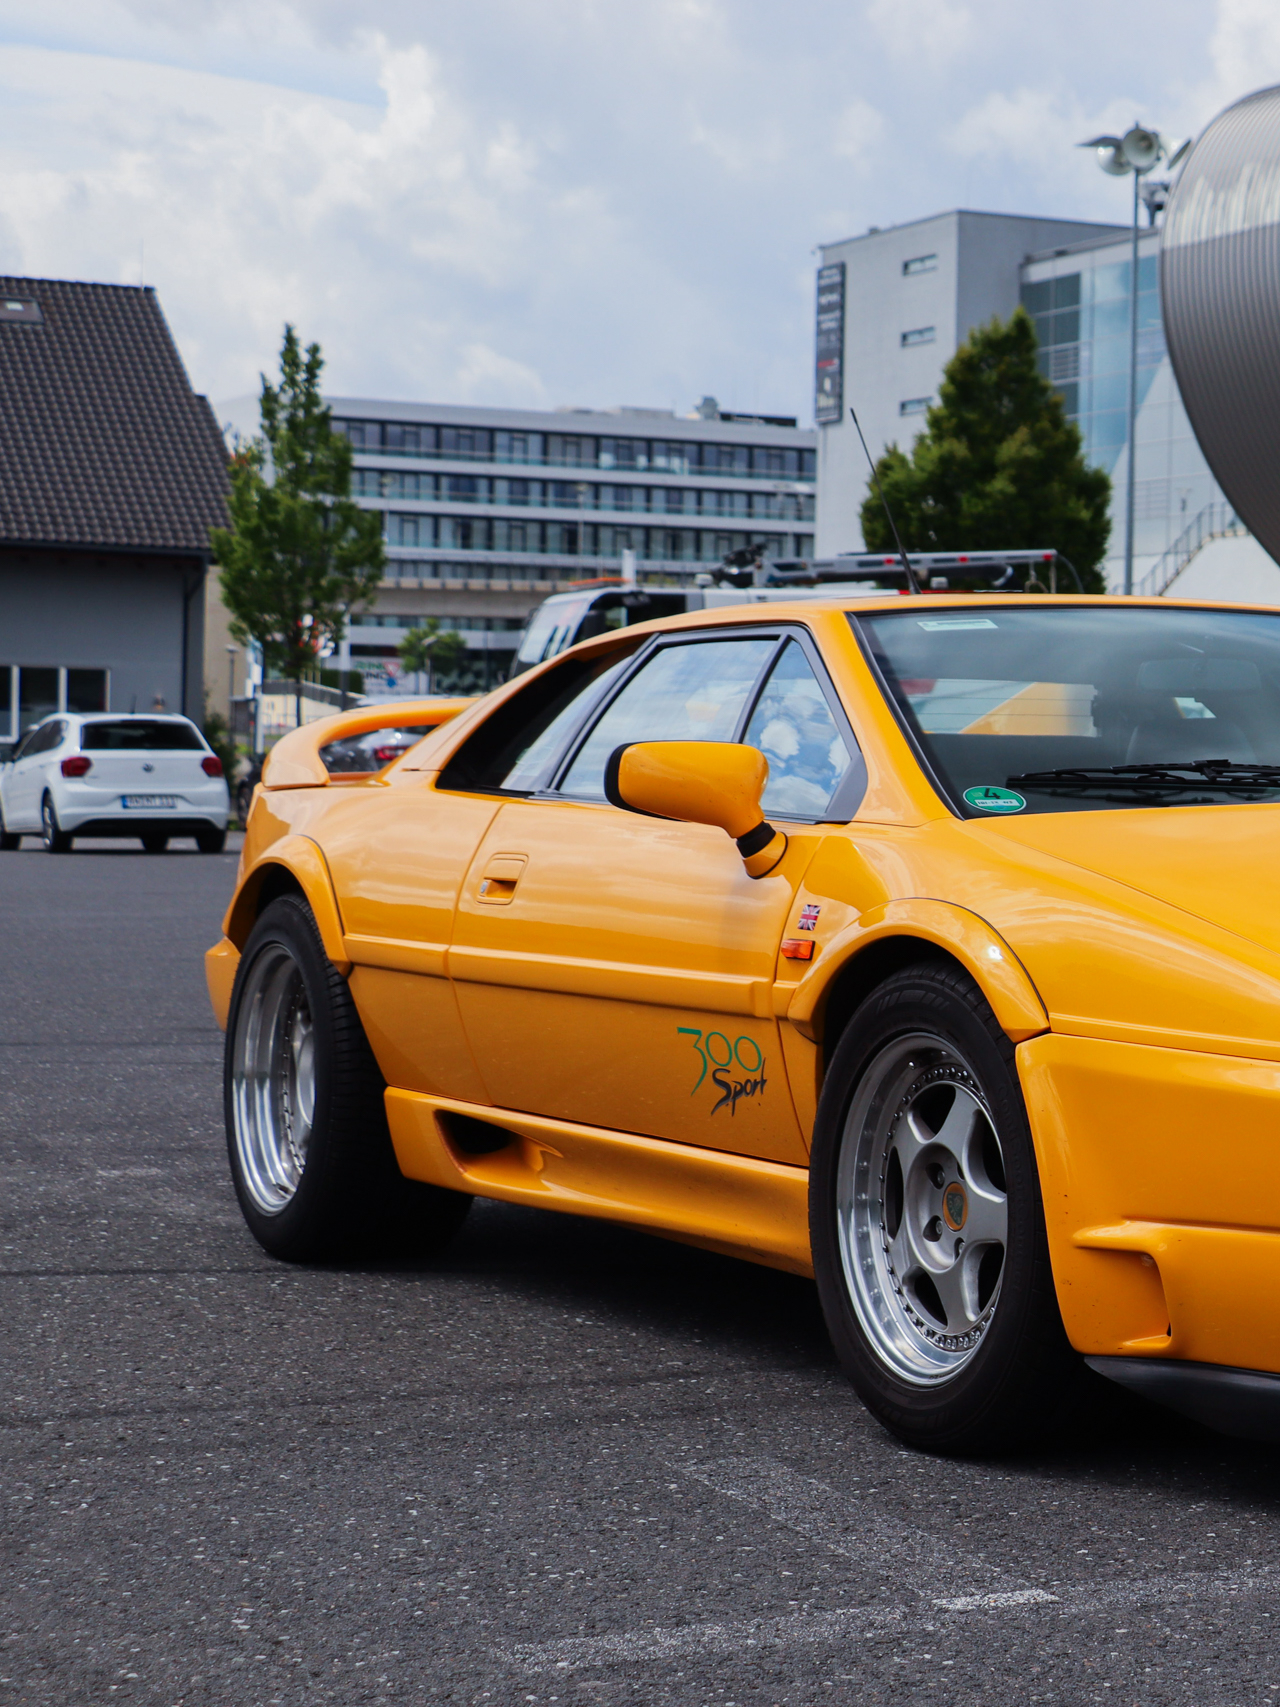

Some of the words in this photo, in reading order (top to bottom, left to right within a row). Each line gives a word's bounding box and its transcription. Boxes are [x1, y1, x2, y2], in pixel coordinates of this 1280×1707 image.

[984, 787, 1001, 799] 4
[676, 1026, 762, 1097] 300
[710, 1057, 768, 1118] Sport
